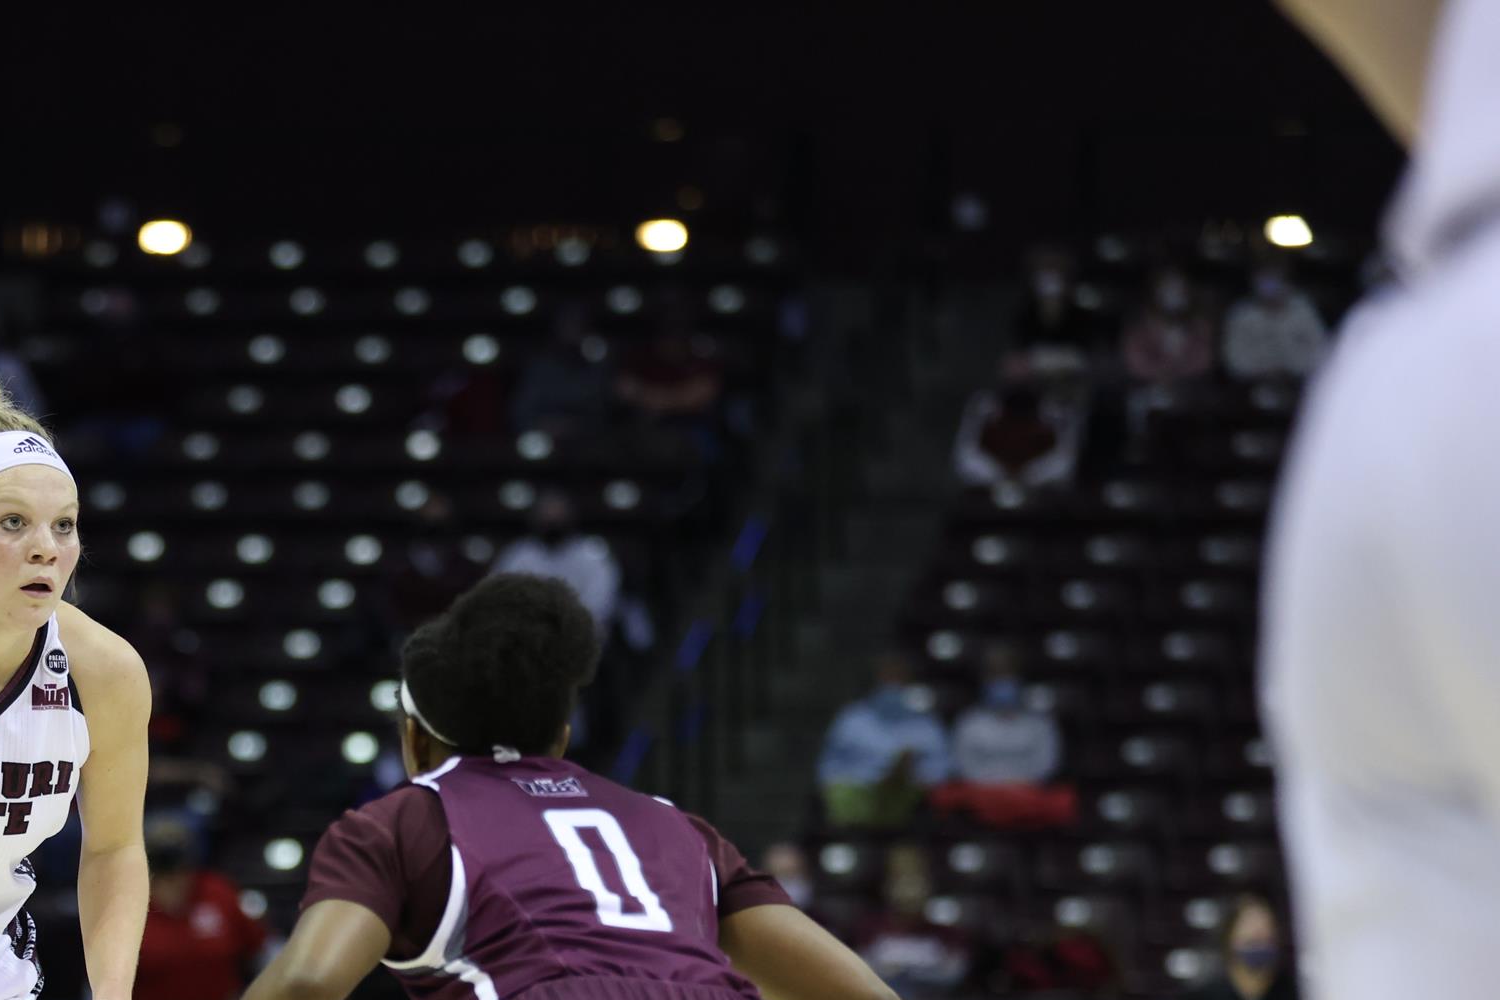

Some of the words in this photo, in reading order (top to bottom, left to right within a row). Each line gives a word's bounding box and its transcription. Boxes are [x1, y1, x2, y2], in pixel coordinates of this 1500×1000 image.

[13, 445, 58, 459] adidas
[48, 660, 68, 669] UNITE
[543, 807, 673, 932] 0
